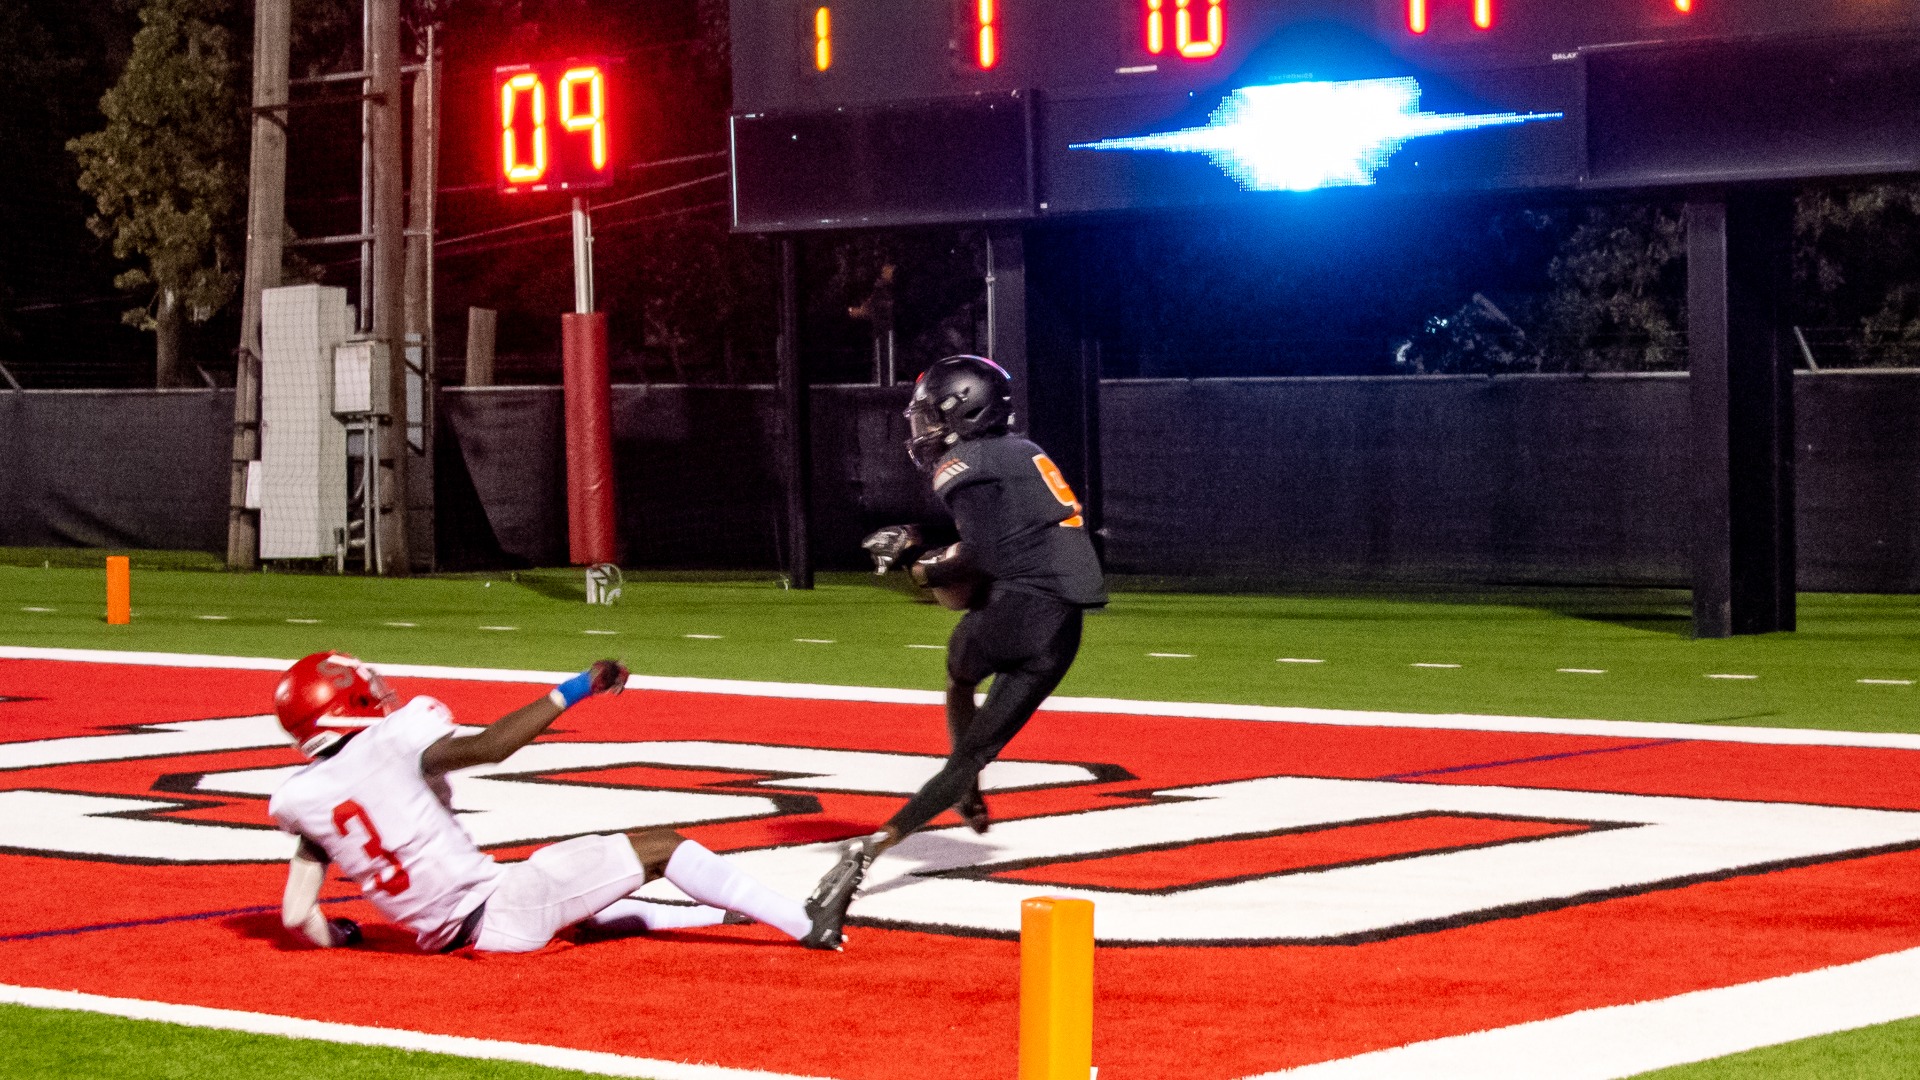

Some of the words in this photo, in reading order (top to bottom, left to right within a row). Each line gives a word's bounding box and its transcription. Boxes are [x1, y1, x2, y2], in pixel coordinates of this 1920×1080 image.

[1551, 52, 1579, 60] GALAX
[502, 66, 606, 183] 09
[331, 798, 411, 896] 3
